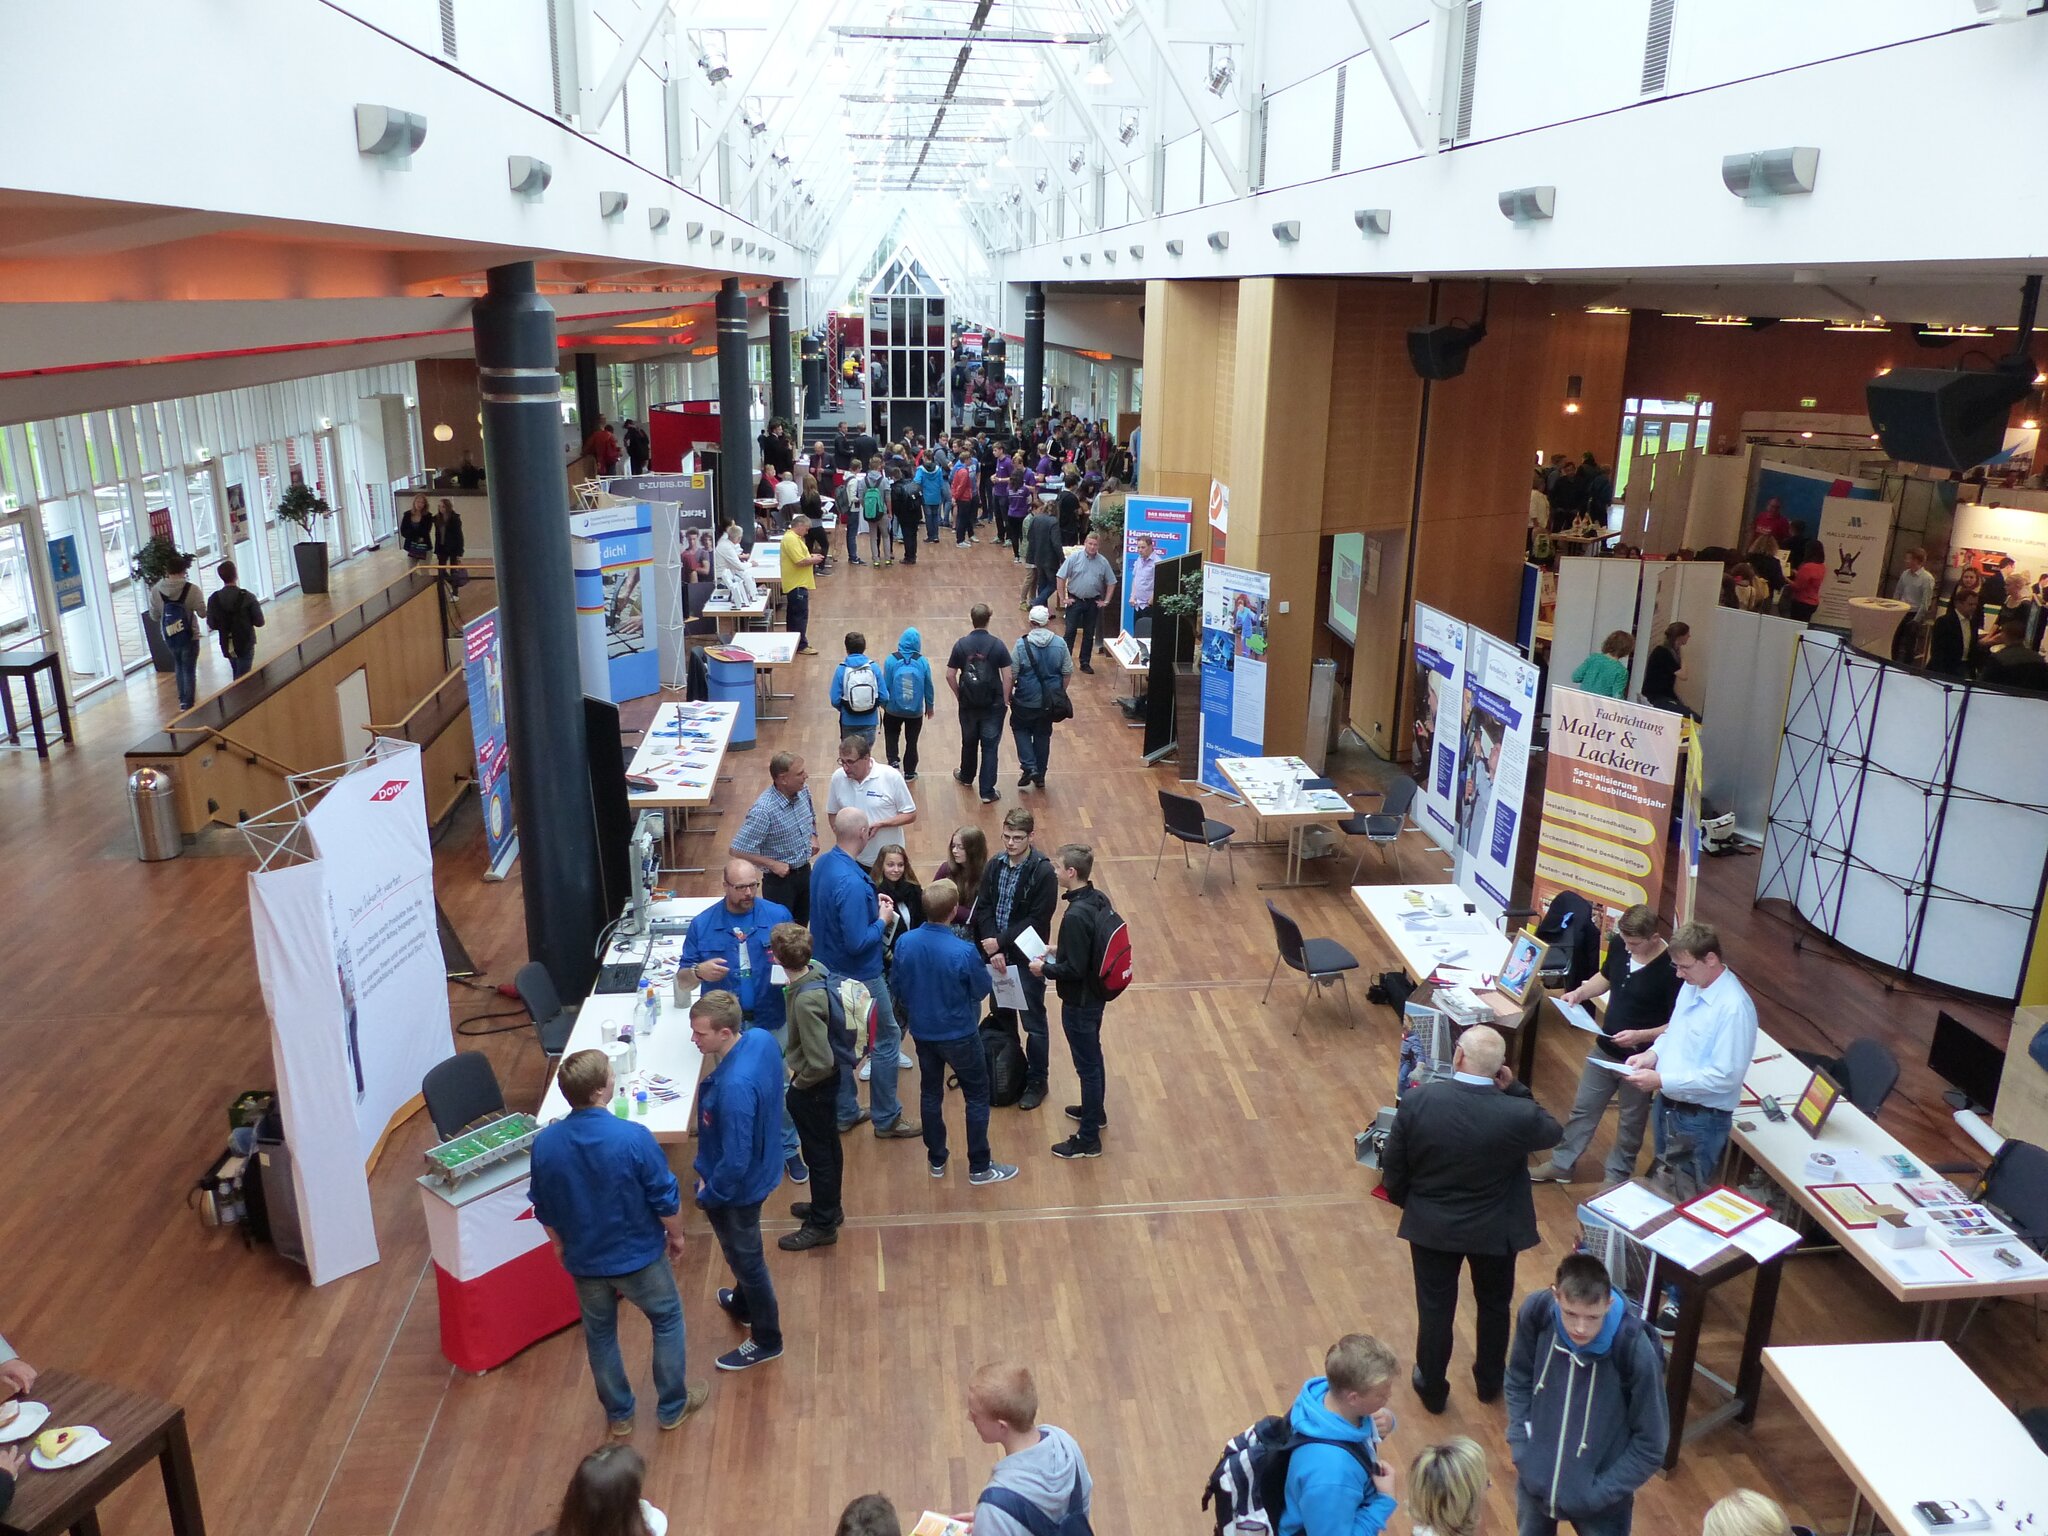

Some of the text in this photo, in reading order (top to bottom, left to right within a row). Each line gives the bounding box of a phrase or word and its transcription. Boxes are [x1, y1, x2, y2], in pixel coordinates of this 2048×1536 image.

[639, 480, 690, 490] E-ZUBIS.DE
[604, 544, 627, 558] dich!
[1558, 715, 1638, 749] Maler &
[1596, 708, 1664, 735] Fachrichtung
[1576, 742, 1659, 777] Lackierer
[1573, 767, 1638, 792] Spezialisierung
[1572, 776, 1666, 809] im 3. Ausbildungsjahr
[1545, 801, 1576, 815] Gestaltung
[1578, 809, 1589, 818] und
[1587, 845, 1597, 854] und
[1600, 850, 1644, 869] Denkmalpflege
[1562, 870, 1573, 878] und
[1575, 874, 1626, 896] Korrosionsschutz
